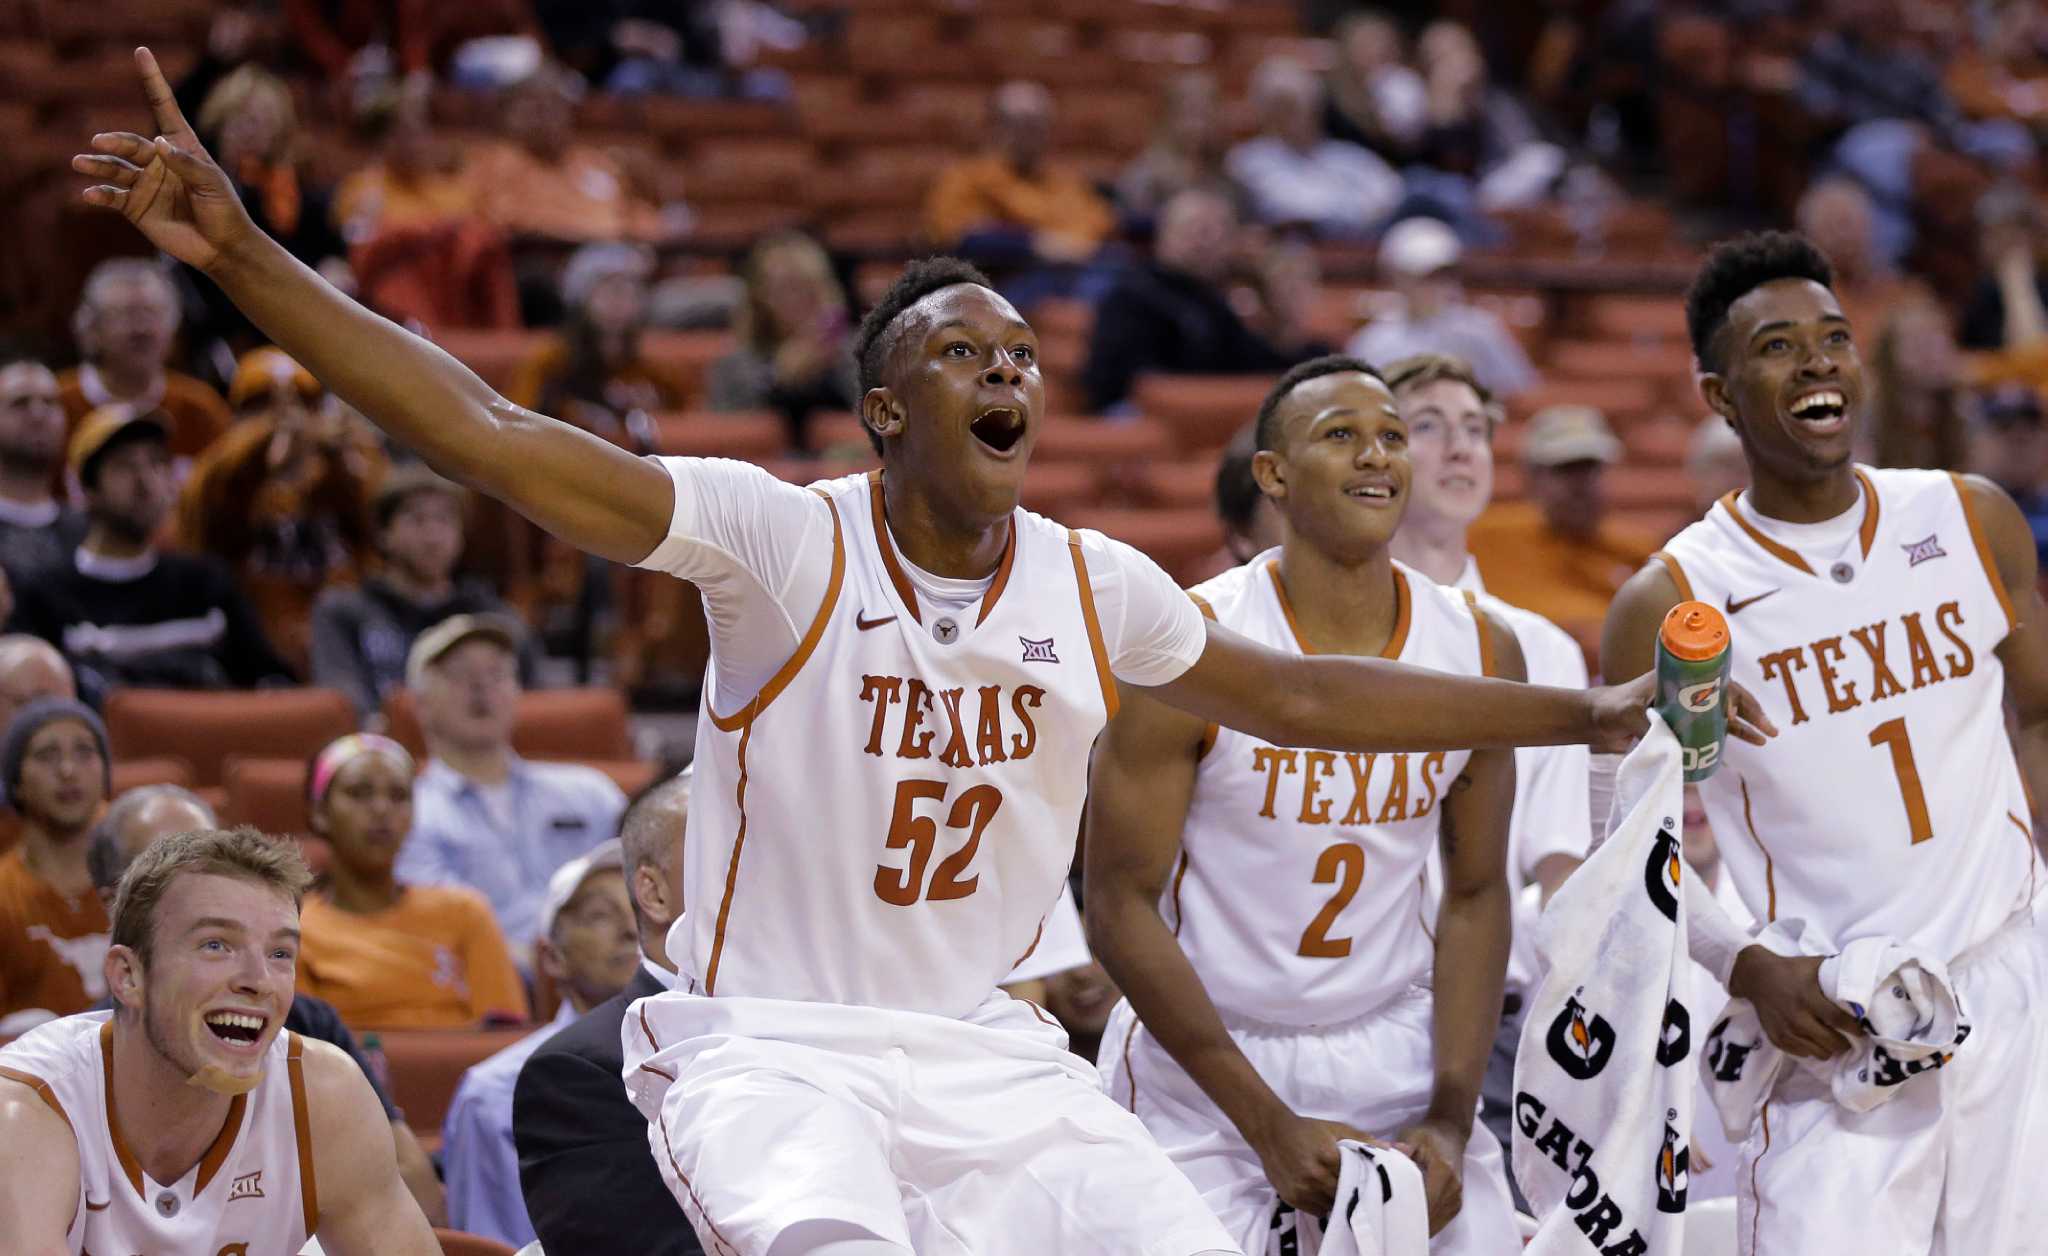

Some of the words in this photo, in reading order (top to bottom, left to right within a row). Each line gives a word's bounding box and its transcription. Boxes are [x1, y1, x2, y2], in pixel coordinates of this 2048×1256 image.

[859, 674, 1047, 769] TEXAS
[1758, 600, 1975, 725] TEXAS
[1251, 747, 1446, 826] TEXAS
[1868, 715, 1934, 846] 1
[873, 778, 1003, 907] 52
[1296, 842, 1366, 959] 2
